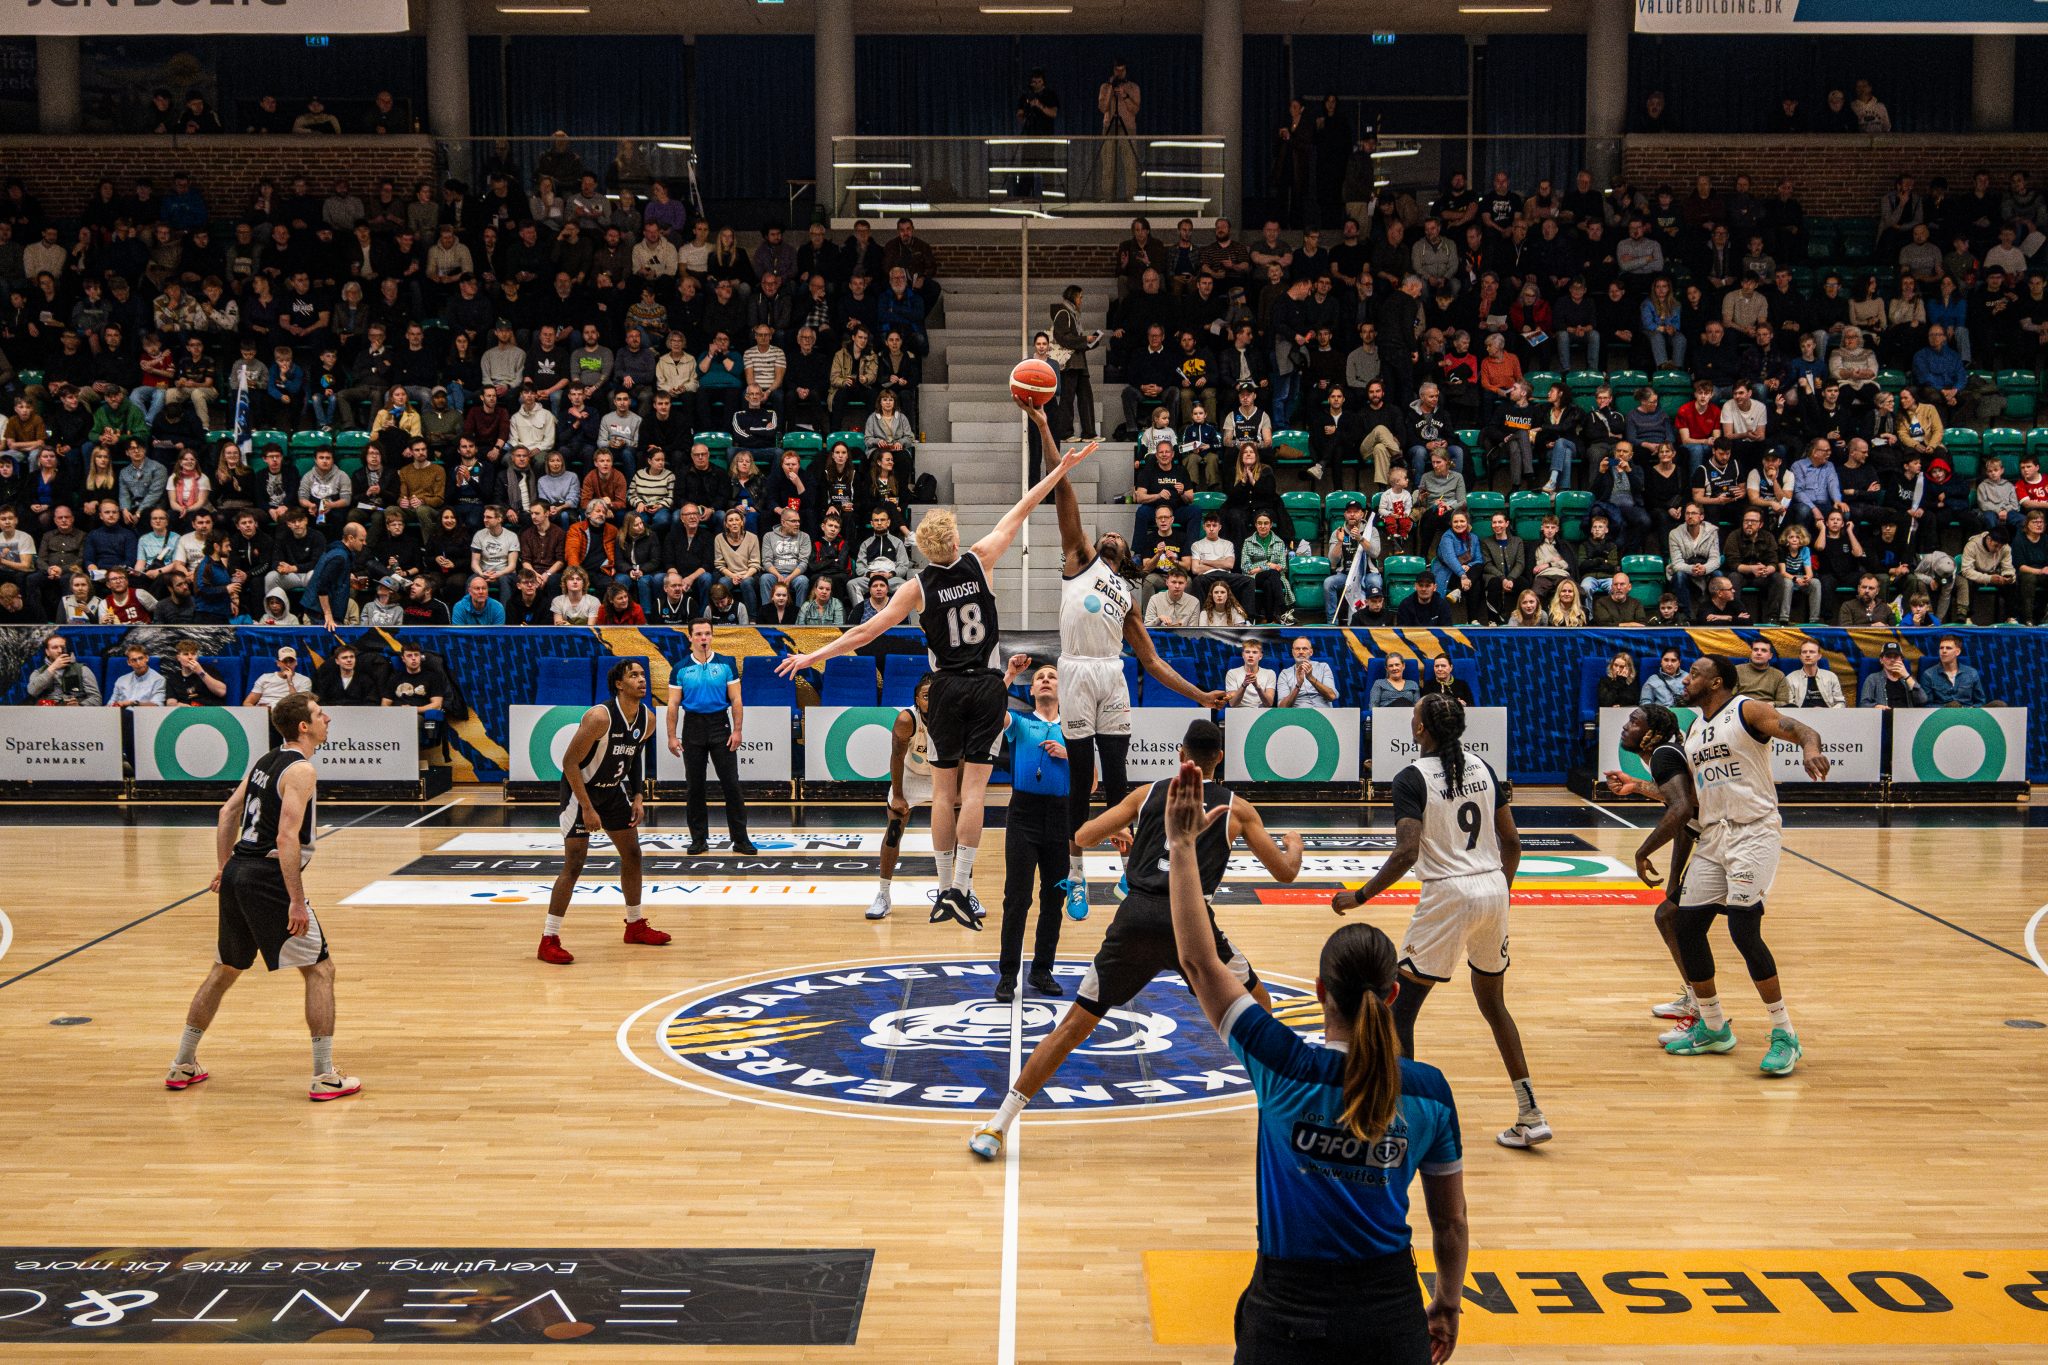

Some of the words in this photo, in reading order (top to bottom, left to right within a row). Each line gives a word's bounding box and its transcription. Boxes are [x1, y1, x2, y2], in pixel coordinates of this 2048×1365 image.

[1505, 414, 1532, 425] VINTAGE
[938, 581, 980, 603] KNUDSEN
[1094, 578, 1129, 612] EAGLES
[947, 602, 986, 648] 18
[1702, 726, 1715, 744] 13
[5, 737, 104, 754] Sparekassen
[314, 737, 400, 754] parekassen
[26, 757, 86, 765] DANMARK
[322, 757, 382, 765] DANMARK
[1693, 744, 1731, 767] EAGLES
[1704, 762, 1741, 781] ONE
[242, 793, 261, 843] 12
[1457, 801, 1482, 851] 9
[702, 964, 996, 1019] BAKKEN
[705, 1045, 987, 1103] BEARS
[13, 1260, 112, 1271] more.
[120, 1261, 171, 1273] bit
[182, 1261, 253, 1274] little
[261, 1261, 283, 1271] a
[290, 1261, 362, 1273] and
[1420, 1270, 1955, 1315] OLESEN
[64, 1288, 160, 1327] &
[151, 1288, 691, 1324] EVENT
